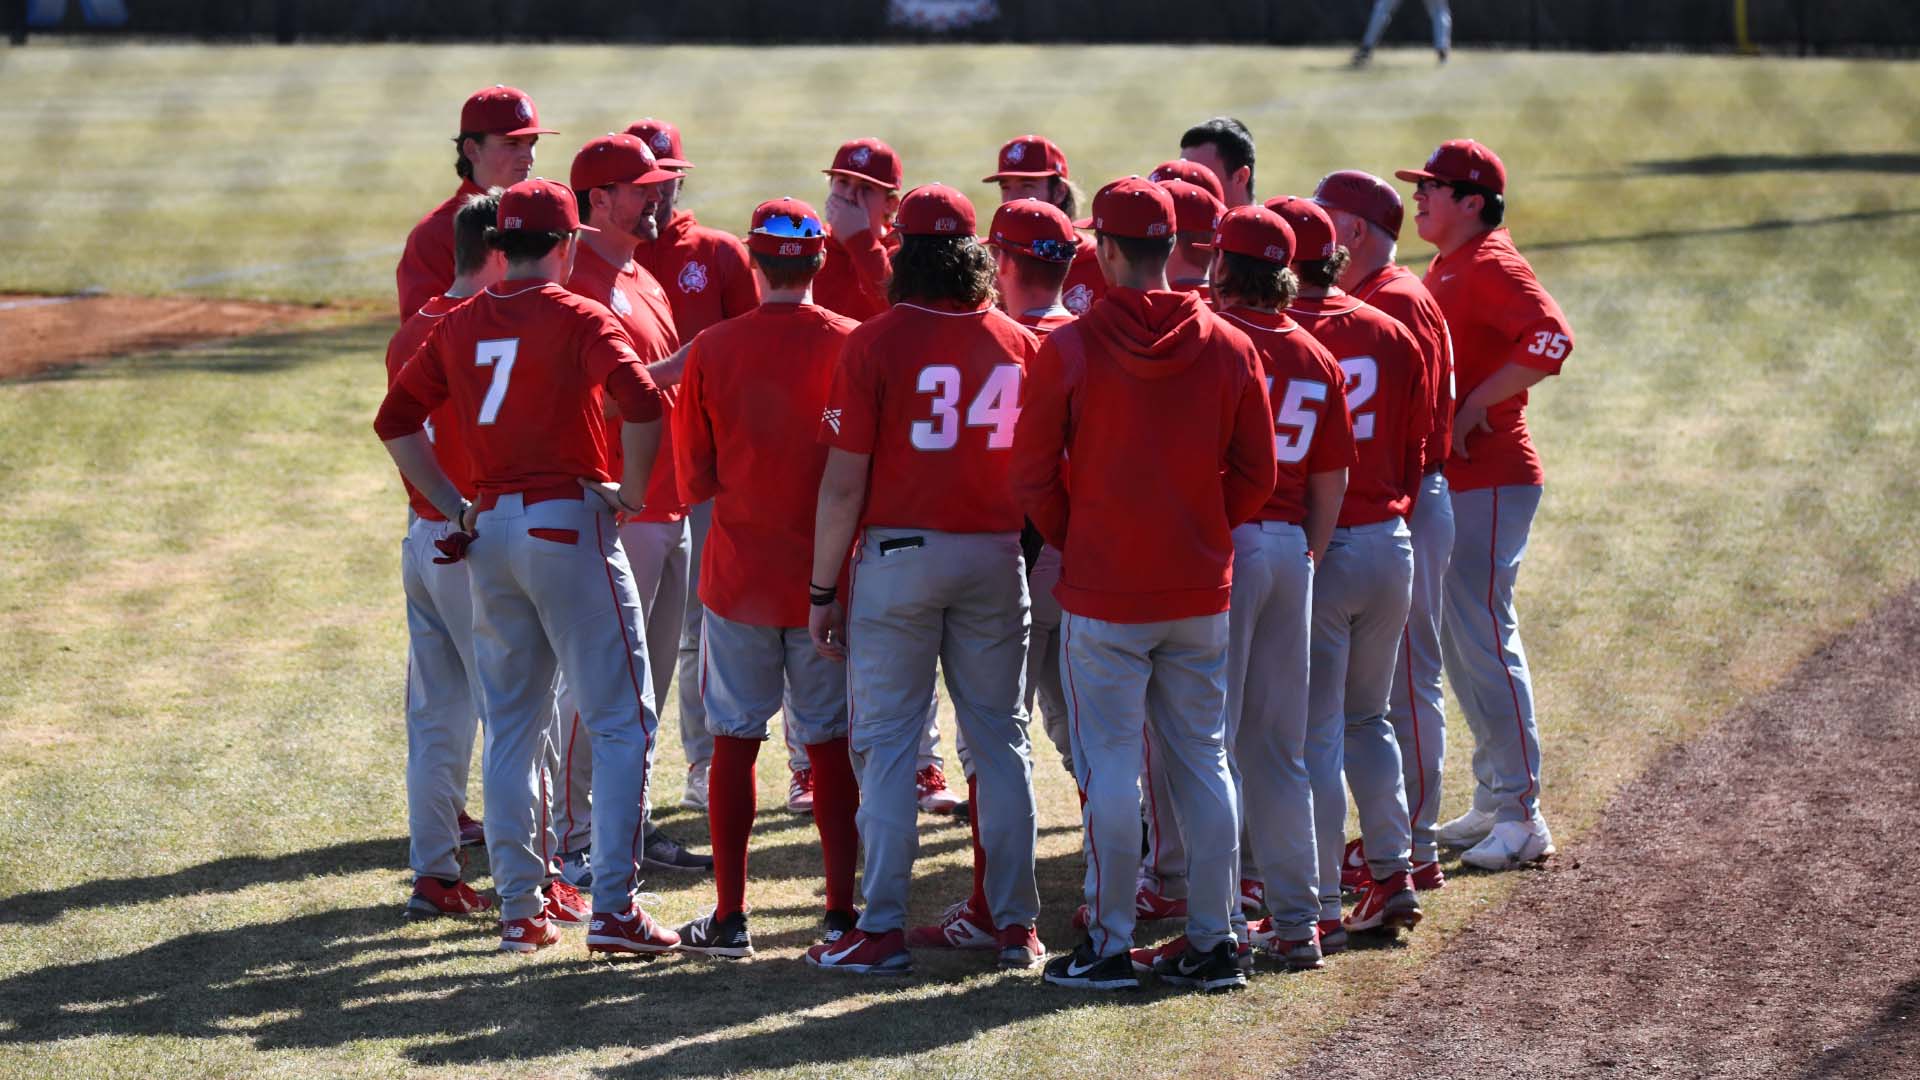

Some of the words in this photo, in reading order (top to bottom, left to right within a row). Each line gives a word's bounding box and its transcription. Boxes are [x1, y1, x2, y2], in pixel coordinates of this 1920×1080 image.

[475, 338, 520, 425] 7
[1528, 330, 1568, 360] 35
[911, 363, 1022, 450] 34
[1265, 375, 1328, 464] 5
